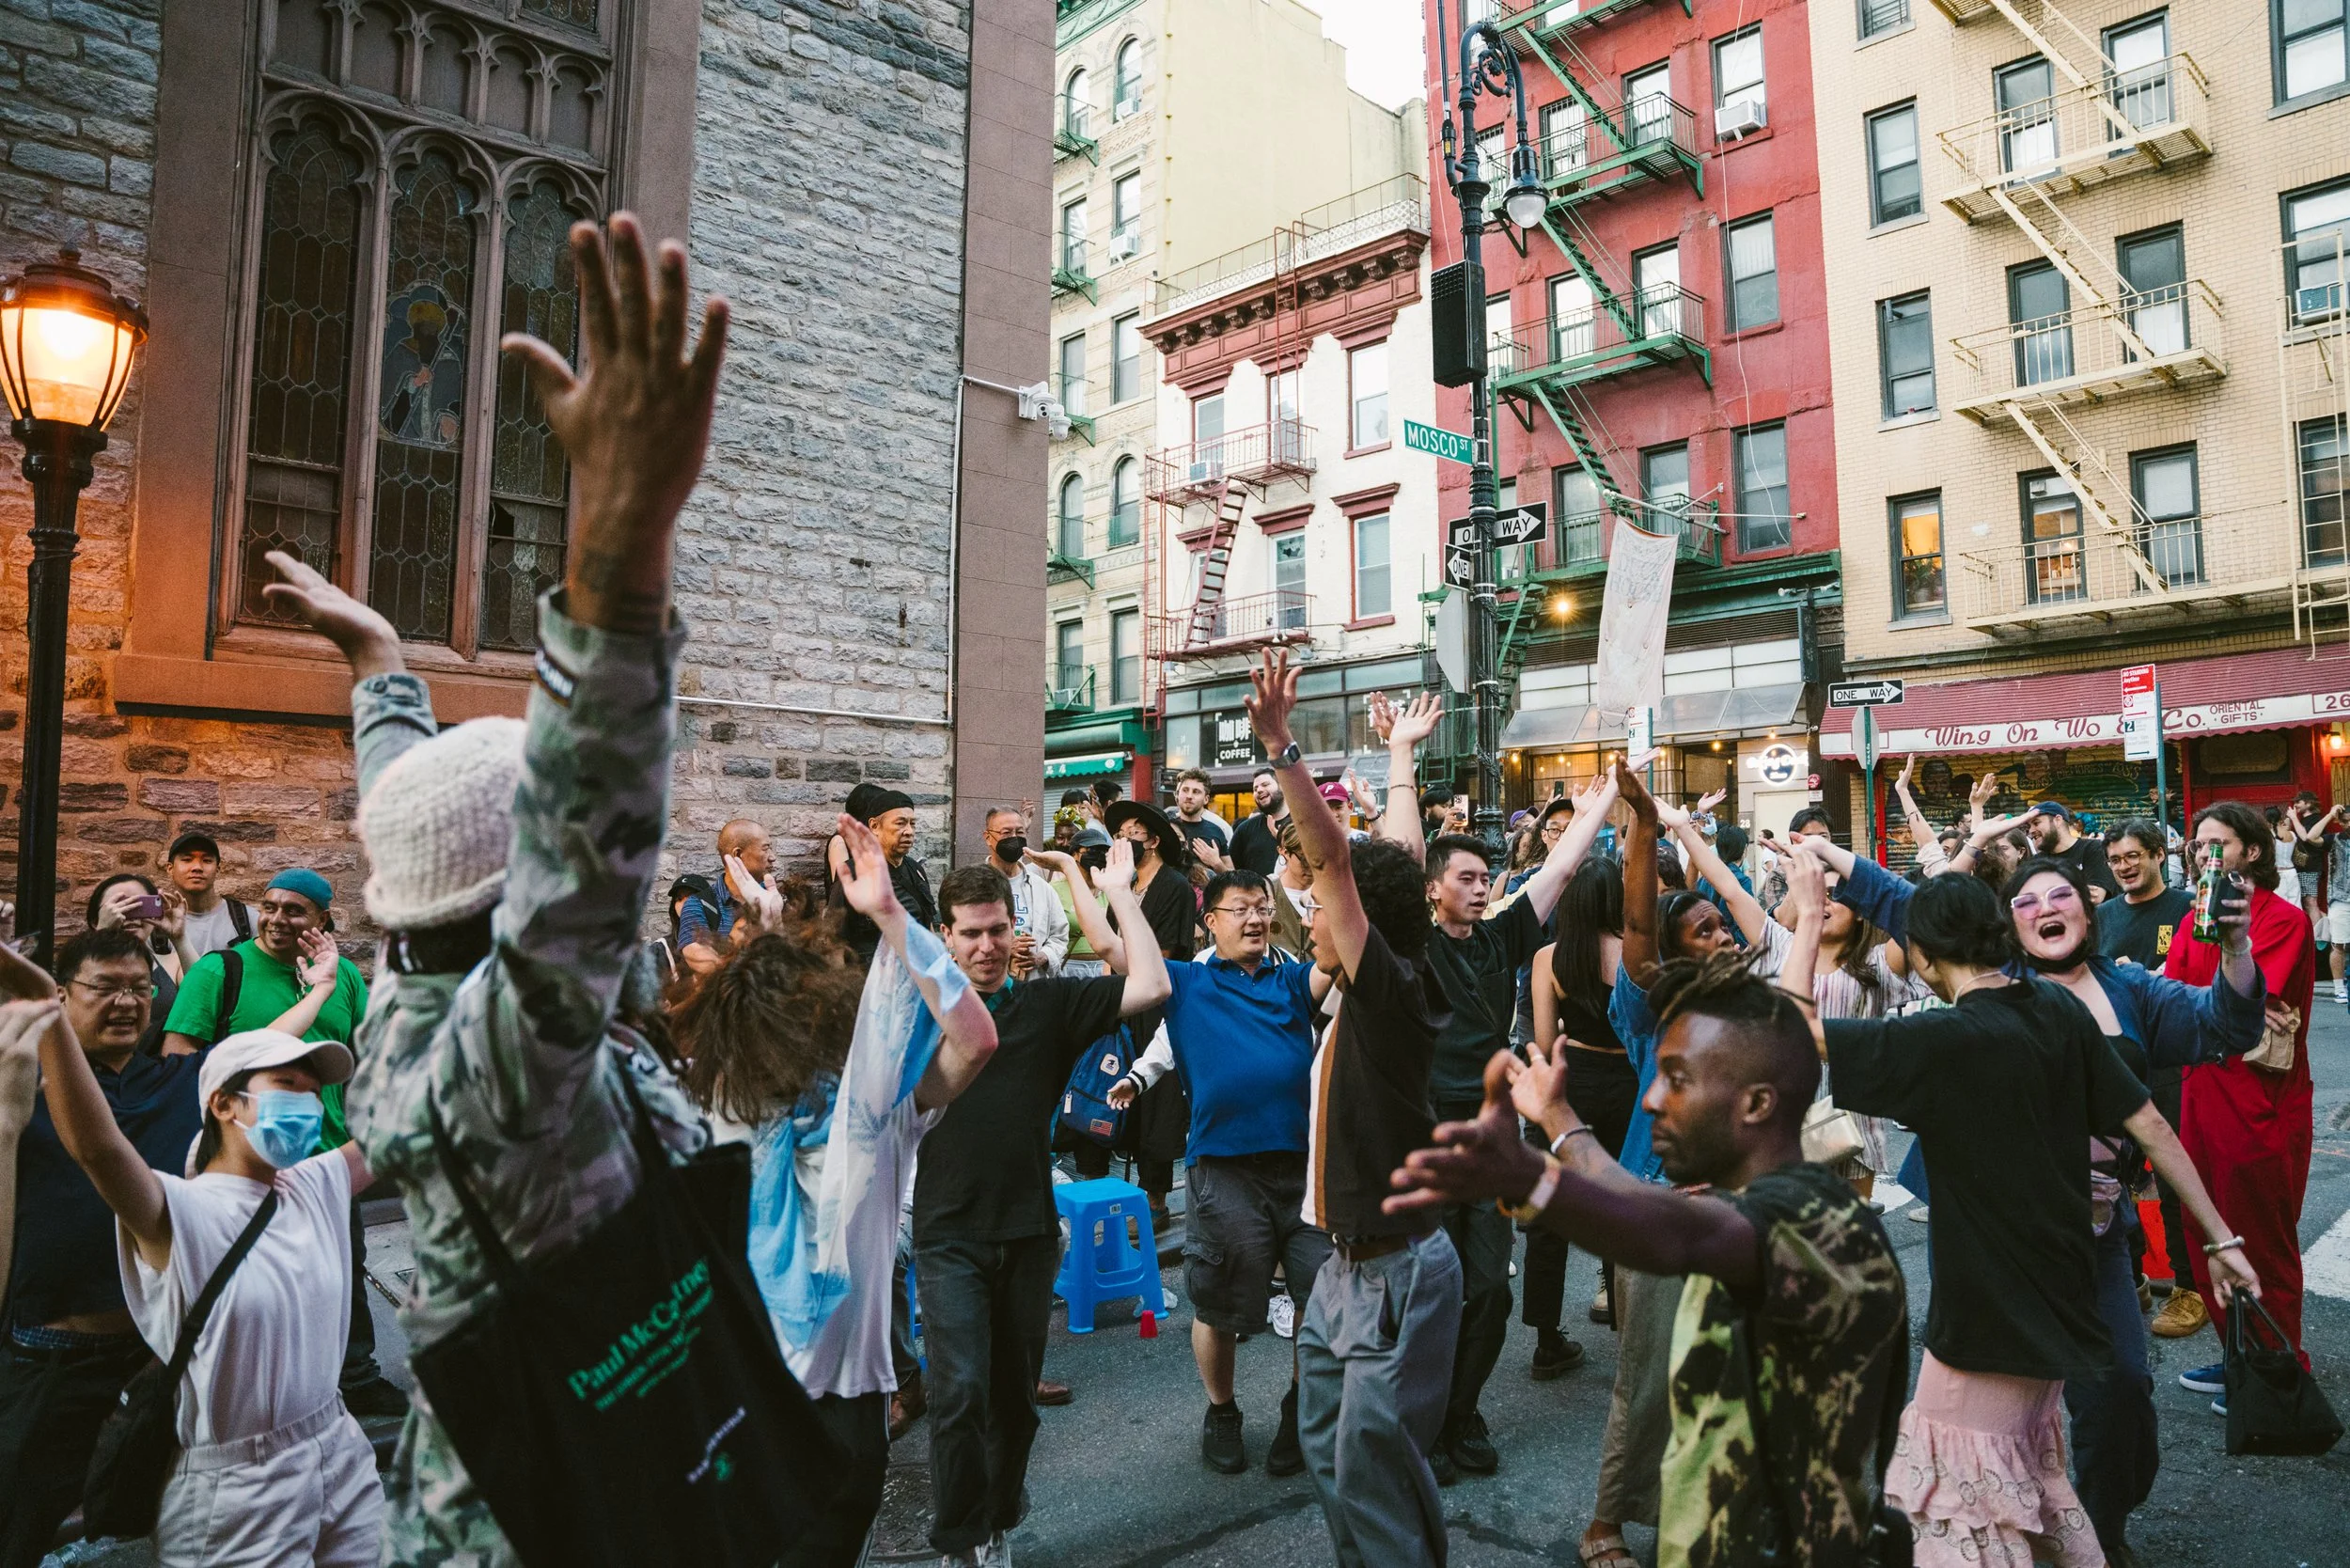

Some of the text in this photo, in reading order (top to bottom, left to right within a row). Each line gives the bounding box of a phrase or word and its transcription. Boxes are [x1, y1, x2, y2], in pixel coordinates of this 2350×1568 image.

[1407, 423, 1469, 458] MOSCO ST
[1502, 516, 1531, 536] WAY
[1452, 558, 1468, 577] ONE
[1836, 687, 1893, 700] ONE WAY
[2209, 700, 2264, 714] ORIENTAL
[2325, 694, 2350, 710] 26
[2220, 712, 2258, 724] GIFTS
[1924, 727, 1991, 746] Wing
[2007, 723, 2038, 744] On
[2055, 718, 2101, 738] Wo
[2163, 709, 2206, 729] Co.
[1219, 748, 1251, 760] COFFEE
[1740, 819, 1750, 828] 28
[1608, 838, 1613, 849] P
[568, 1344, 624, 1399] Paul
